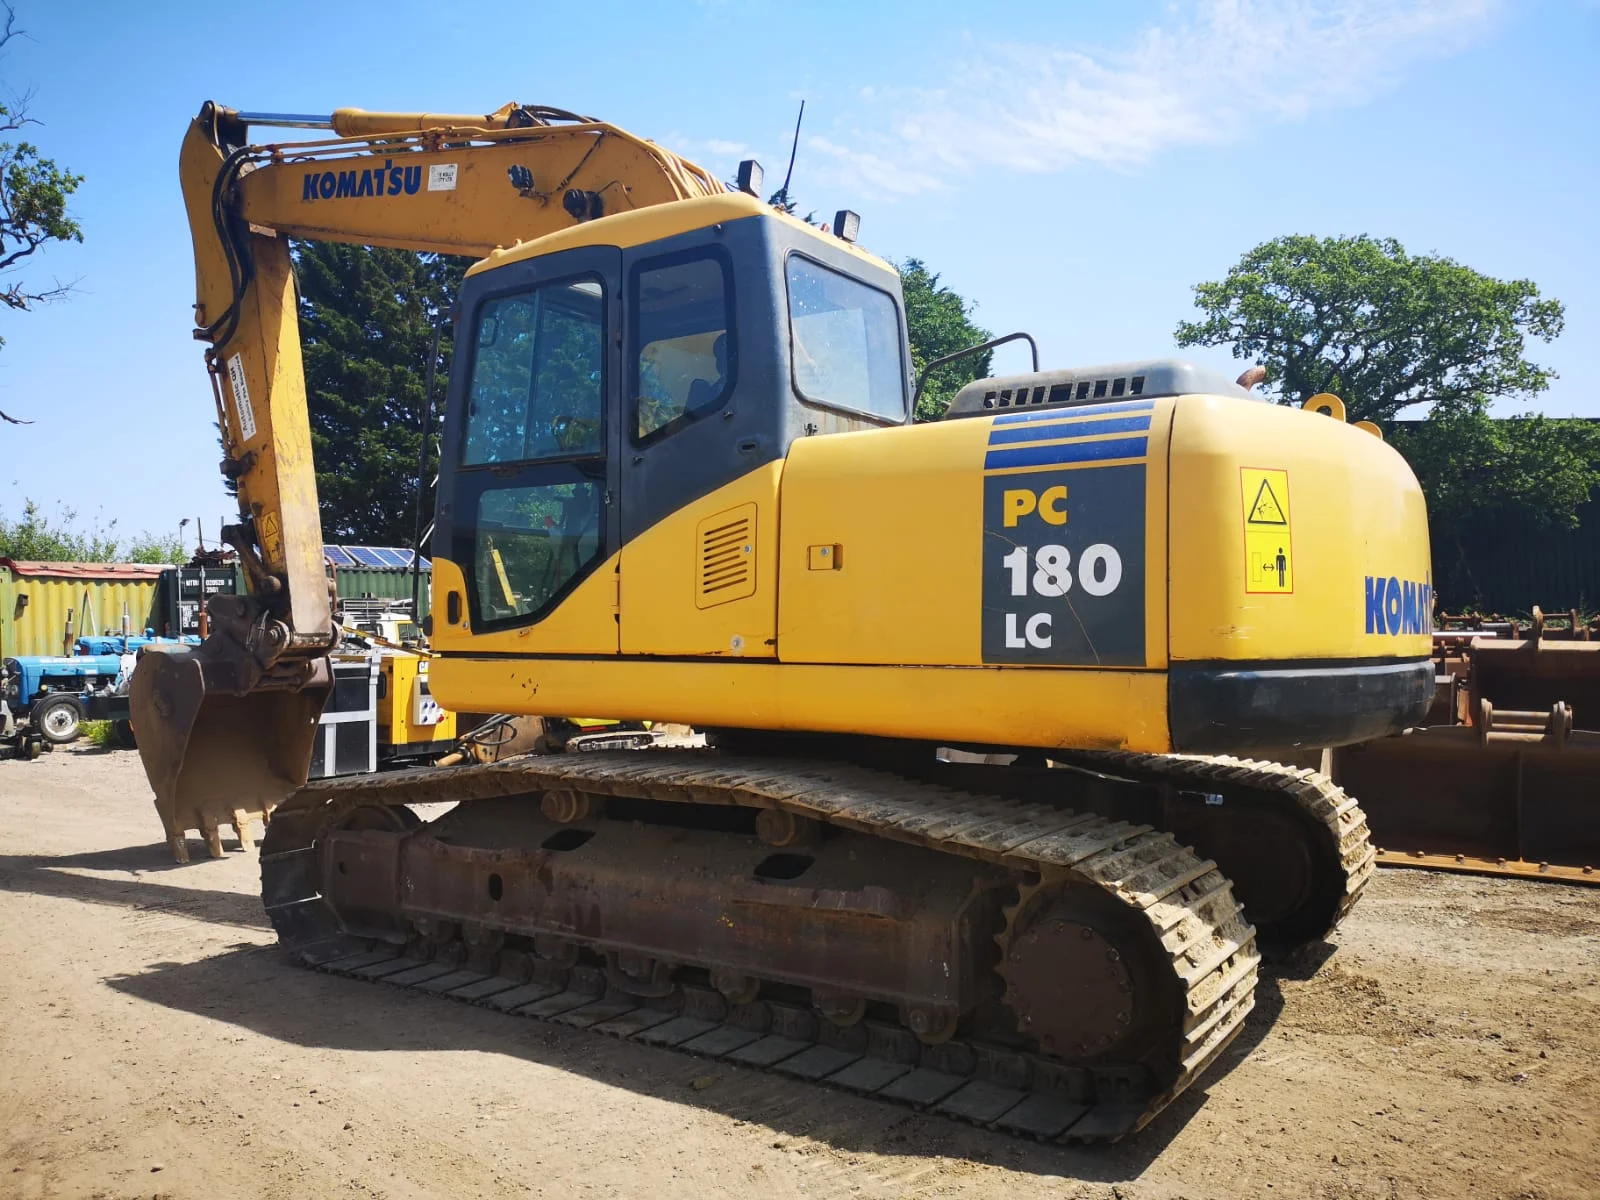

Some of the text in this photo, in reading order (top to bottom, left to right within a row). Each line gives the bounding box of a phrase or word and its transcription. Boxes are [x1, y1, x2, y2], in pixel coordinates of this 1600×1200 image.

[303, 160, 421, 200] KOMATSU
[234, 383, 248, 431] Automatic
[1003, 485, 1068, 528] PC
[1003, 543, 1122, 597] 180
[1005, 612, 1052, 649] LC
